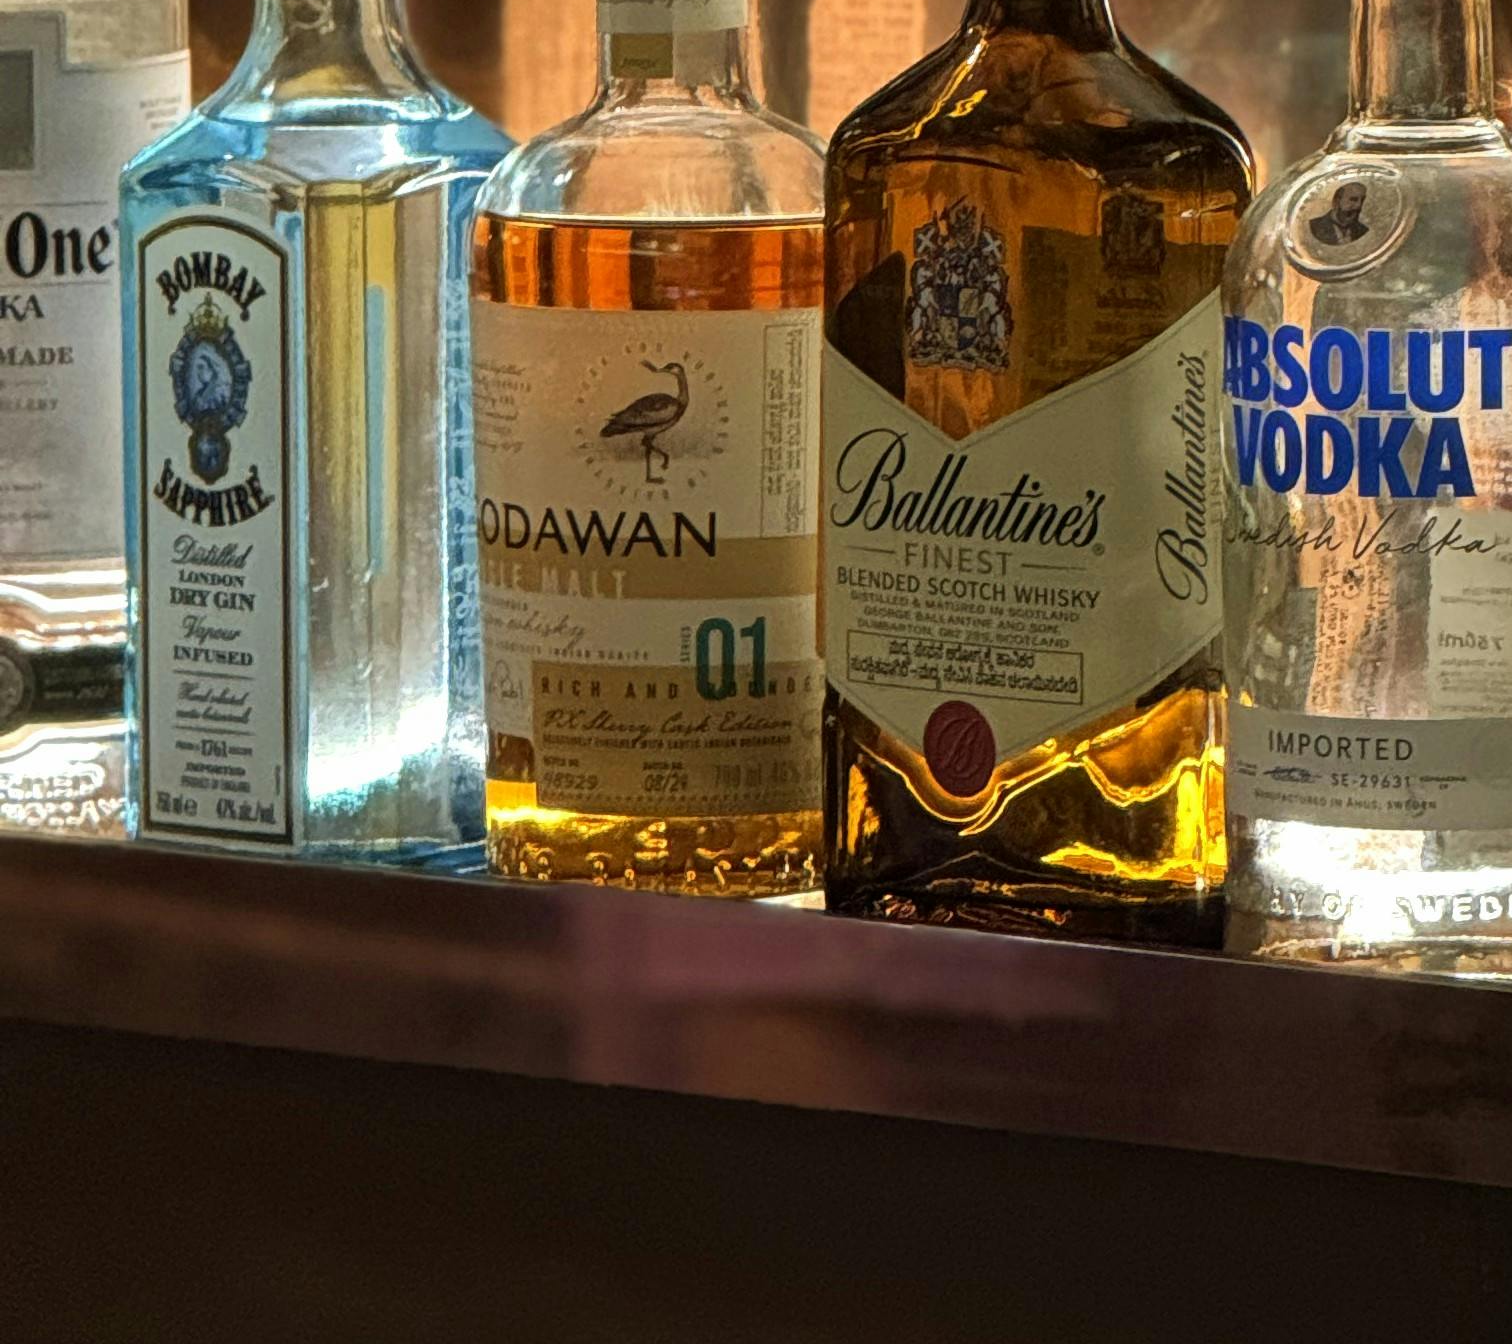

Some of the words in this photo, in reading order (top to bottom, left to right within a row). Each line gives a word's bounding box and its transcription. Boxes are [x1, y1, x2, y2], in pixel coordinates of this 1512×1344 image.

[6, 211, 114, 278] One
[155, 251, 267, 322] BOMBAY
[1232, 404, 1478, 499] VODKA
[154, 458, 276, 528] SAPPHIRE
[830, 427, 1107, 548] Ballantine's
[1154, 351, 1209, 606] Ballantine's
[480, 497, 717, 559] ODAWAN
[1351, 509, 1497, 560] Vodka
[170, 533, 254, 570] Distilled
[904, 542, 1014, 576] FINEST
[177, 568, 246, 589] LONDON
[541, 563, 627, 600] MALT
[837, 566, 921, 593] BLENDED
[927, 576, 1007, 603] SCOTCH
[1013, 585, 1102, 610] WHISKY
[169, 586, 212, 608] DRY
[212, 588, 257, 612] GIN
[987, 606, 1005, 617] IN
[1007, 607, 1081, 624] SCOTLAND
[182, 614, 242, 646] Vapour
[914, 609, 994, 629] BALLANTINE
[996, 619, 1027, 631] AND
[173, 645, 254, 667] INFUSED
[995, 630, 1071, 649] SCOTLAND
[696, 616, 768, 701] 01
[541, 676, 602, 699] RICH
[624, 679, 680, 701] AND
[544, 708, 582, 732] PX
[583, 708, 651, 743] Sherry
[659, 710, 711, 737] Cask
[716, 710, 793, 733] Edition
[200, 738, 229, 759] 1761
[1268, 729, 1414, 762] IMPORTED
[185, 761, 246, 778] IMPORTED
[1386, 797, 1438, 811] SWEDEN
